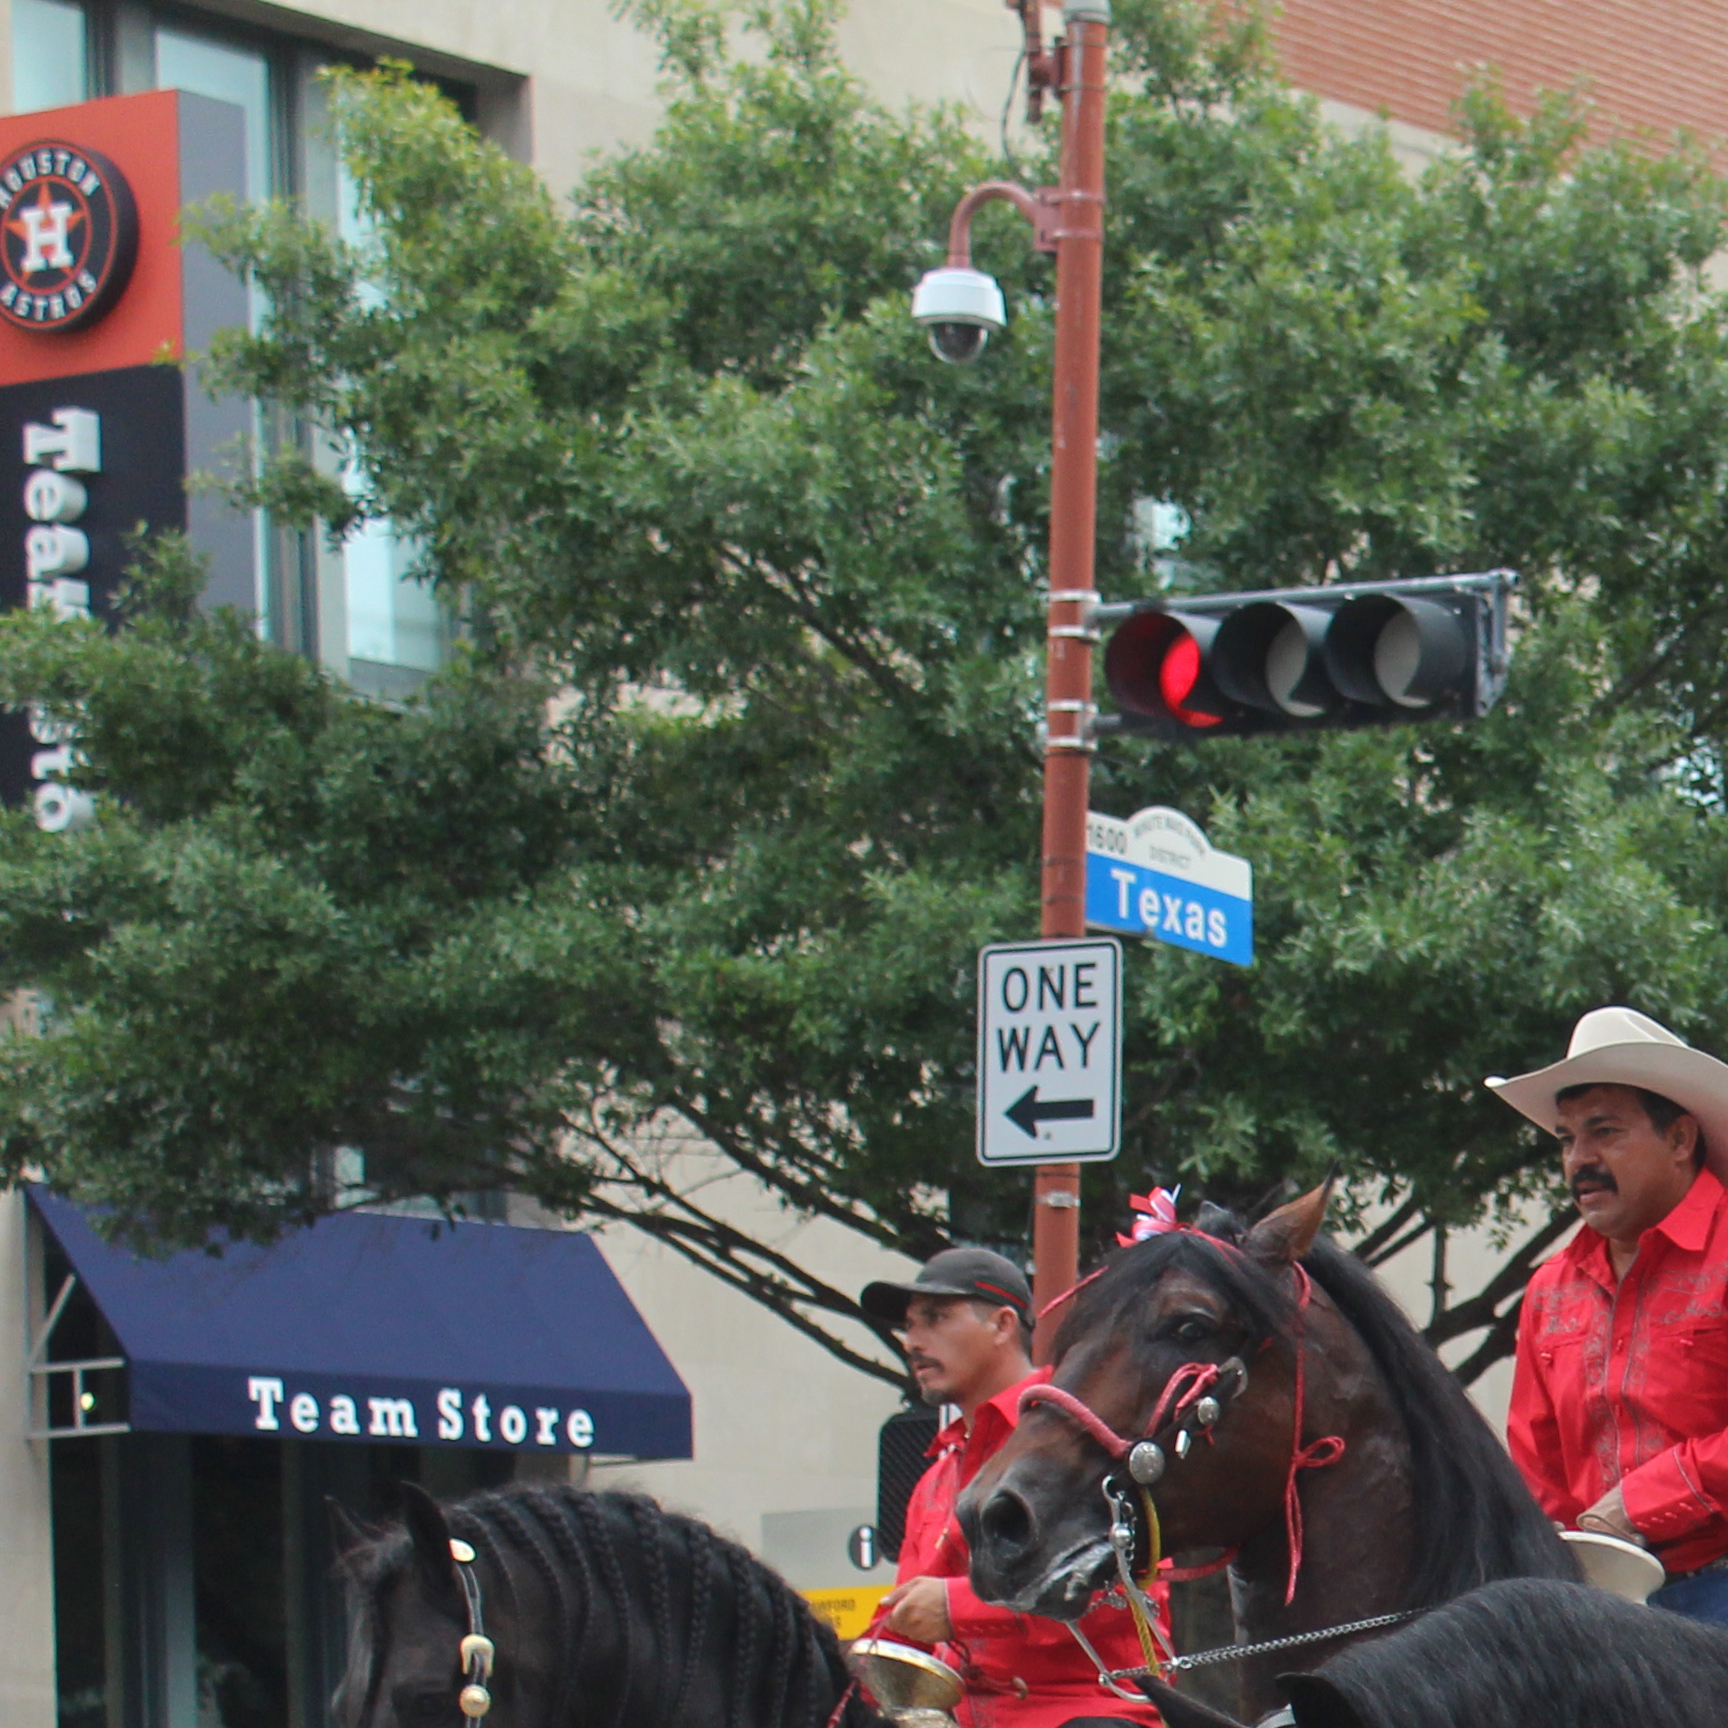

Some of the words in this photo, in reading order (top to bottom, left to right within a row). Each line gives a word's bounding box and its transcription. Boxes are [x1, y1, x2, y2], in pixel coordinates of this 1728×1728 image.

[19, 202, 74, 272] H
[0, 268, 97, 322] ASTROS
[1110, 868, 1228, 949] Texas
[1002, 961, 1099, 1014] ONE
[997, 1020, 1102, 1074] WAY
[248, 1377, 419, 1438] Team
[437, 1387, 596, 1448] Store
